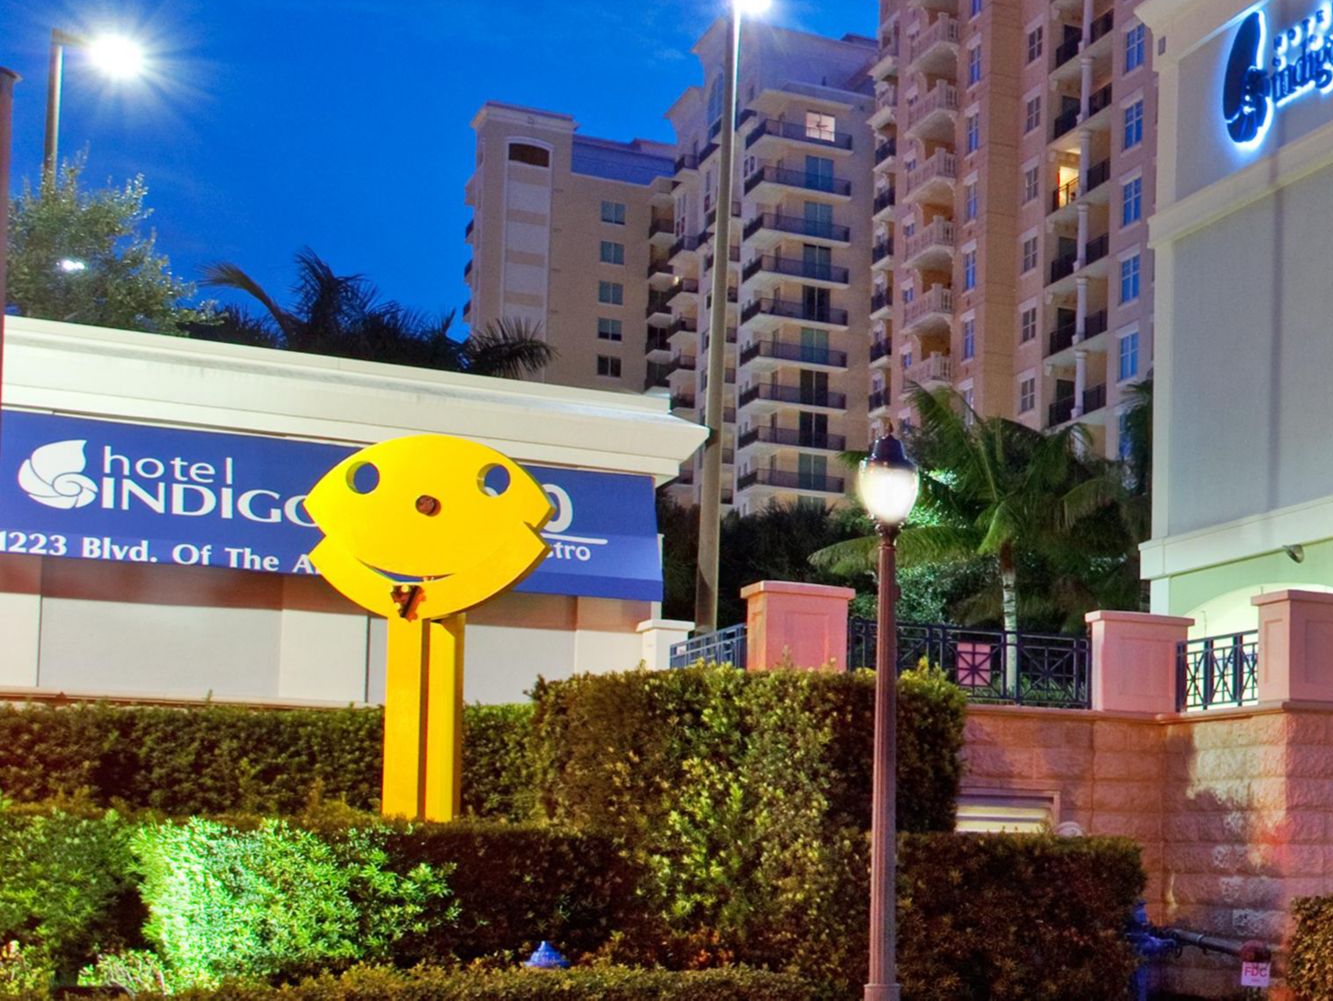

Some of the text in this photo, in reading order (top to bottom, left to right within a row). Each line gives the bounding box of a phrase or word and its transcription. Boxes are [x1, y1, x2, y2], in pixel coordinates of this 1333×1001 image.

[103, 445, 233, 485] hotel
[0, 530, 67, 556] 1223
[82, 536, 158, 563] Blvd.
[172, 543, 212, 566] Of
[225, 547, 279, 572] The
[1244, 966, 1268, 978] FDC
